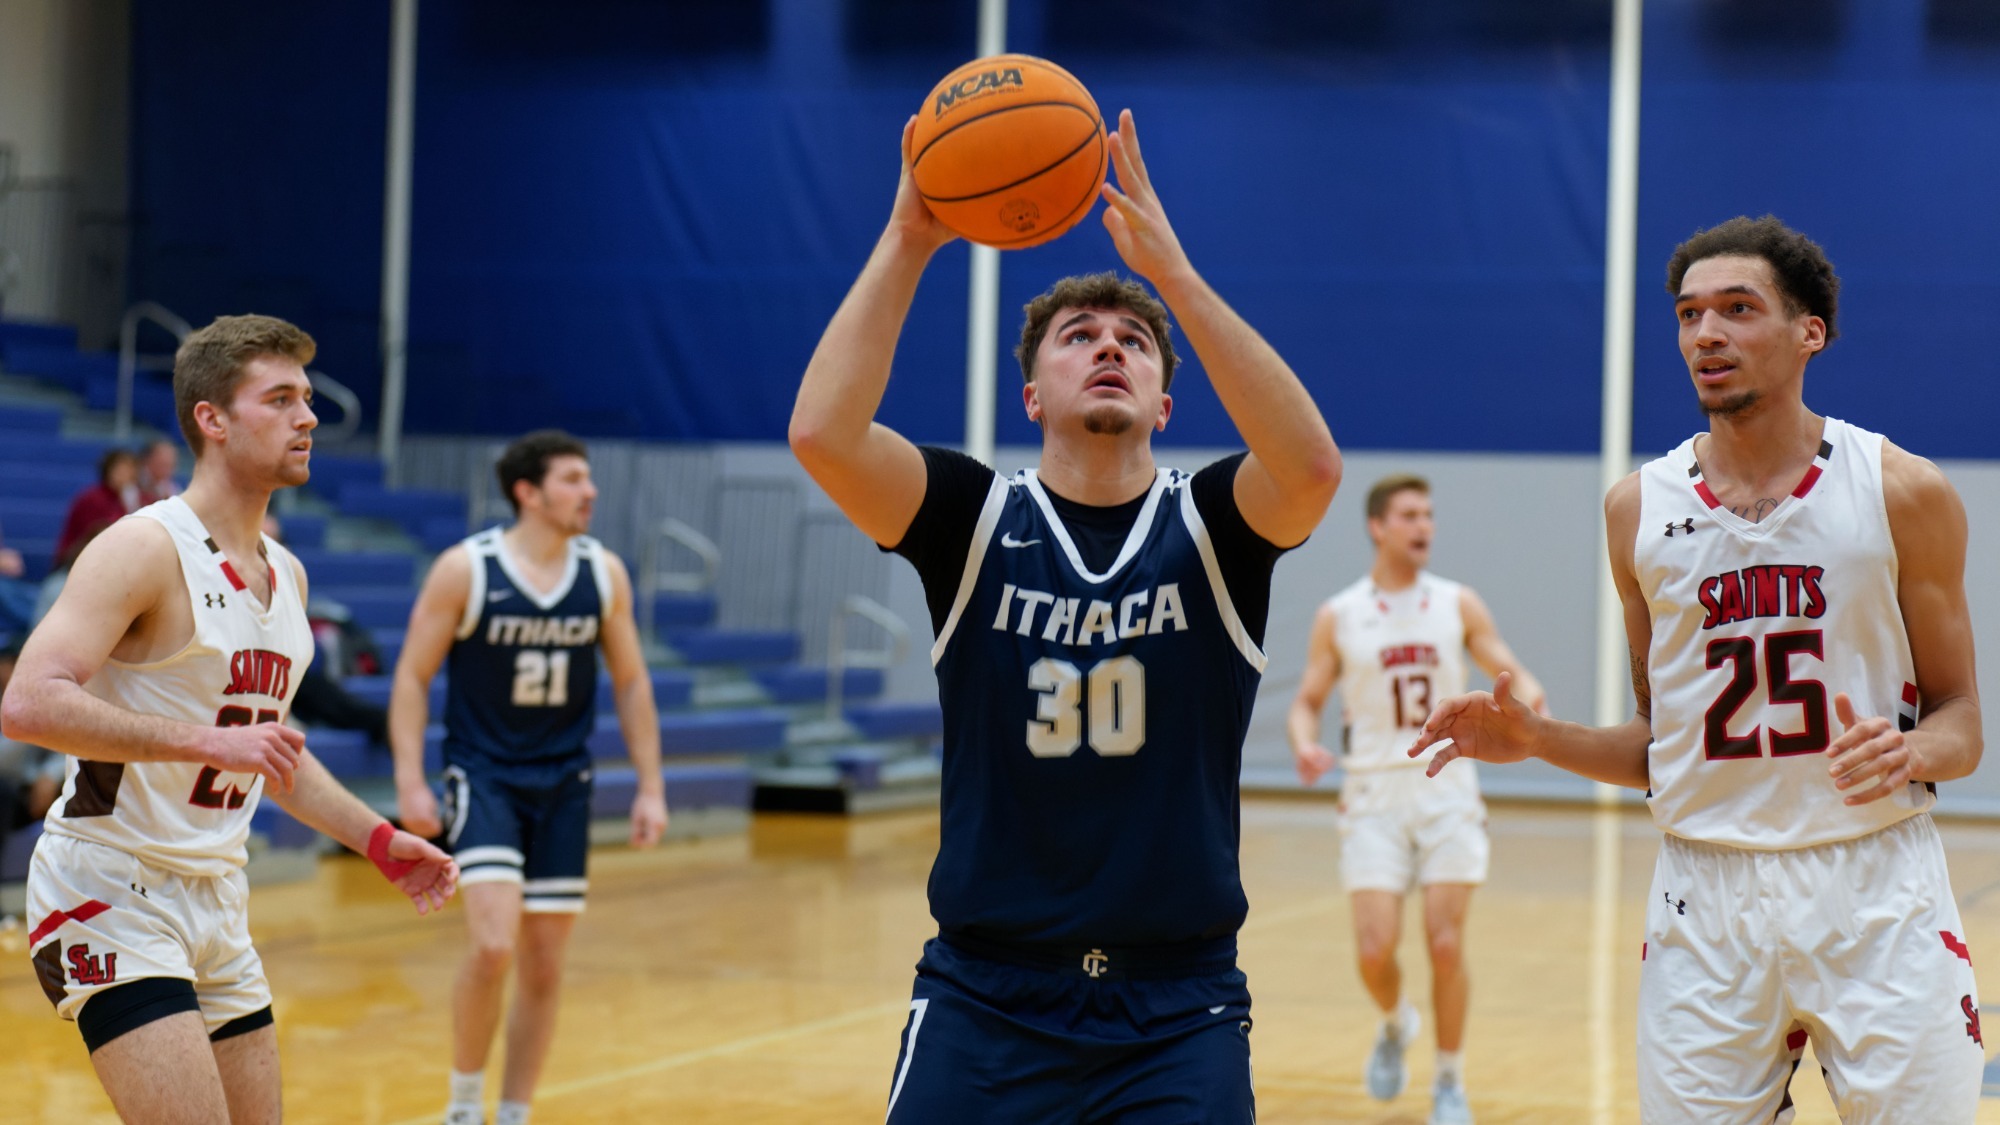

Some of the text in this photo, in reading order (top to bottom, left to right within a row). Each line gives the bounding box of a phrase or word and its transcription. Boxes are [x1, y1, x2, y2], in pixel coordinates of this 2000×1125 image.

[935, 68, 1023, 117] NCAA
[992, 583, 1189, 646] ITHACA
[1698, 565, 1826, 629] SAINTS
[487, 614, 598, 646] ITHACA
[223, 649, 292, 701] SAINTS
[511, 651, 569, 707] 21
[1393, 675, 1431, 728] 13
[1704, 629, 1830, 761] 25
[1026, 655, 1146, 758] 30
[67, 943, 117, 986] SLU
